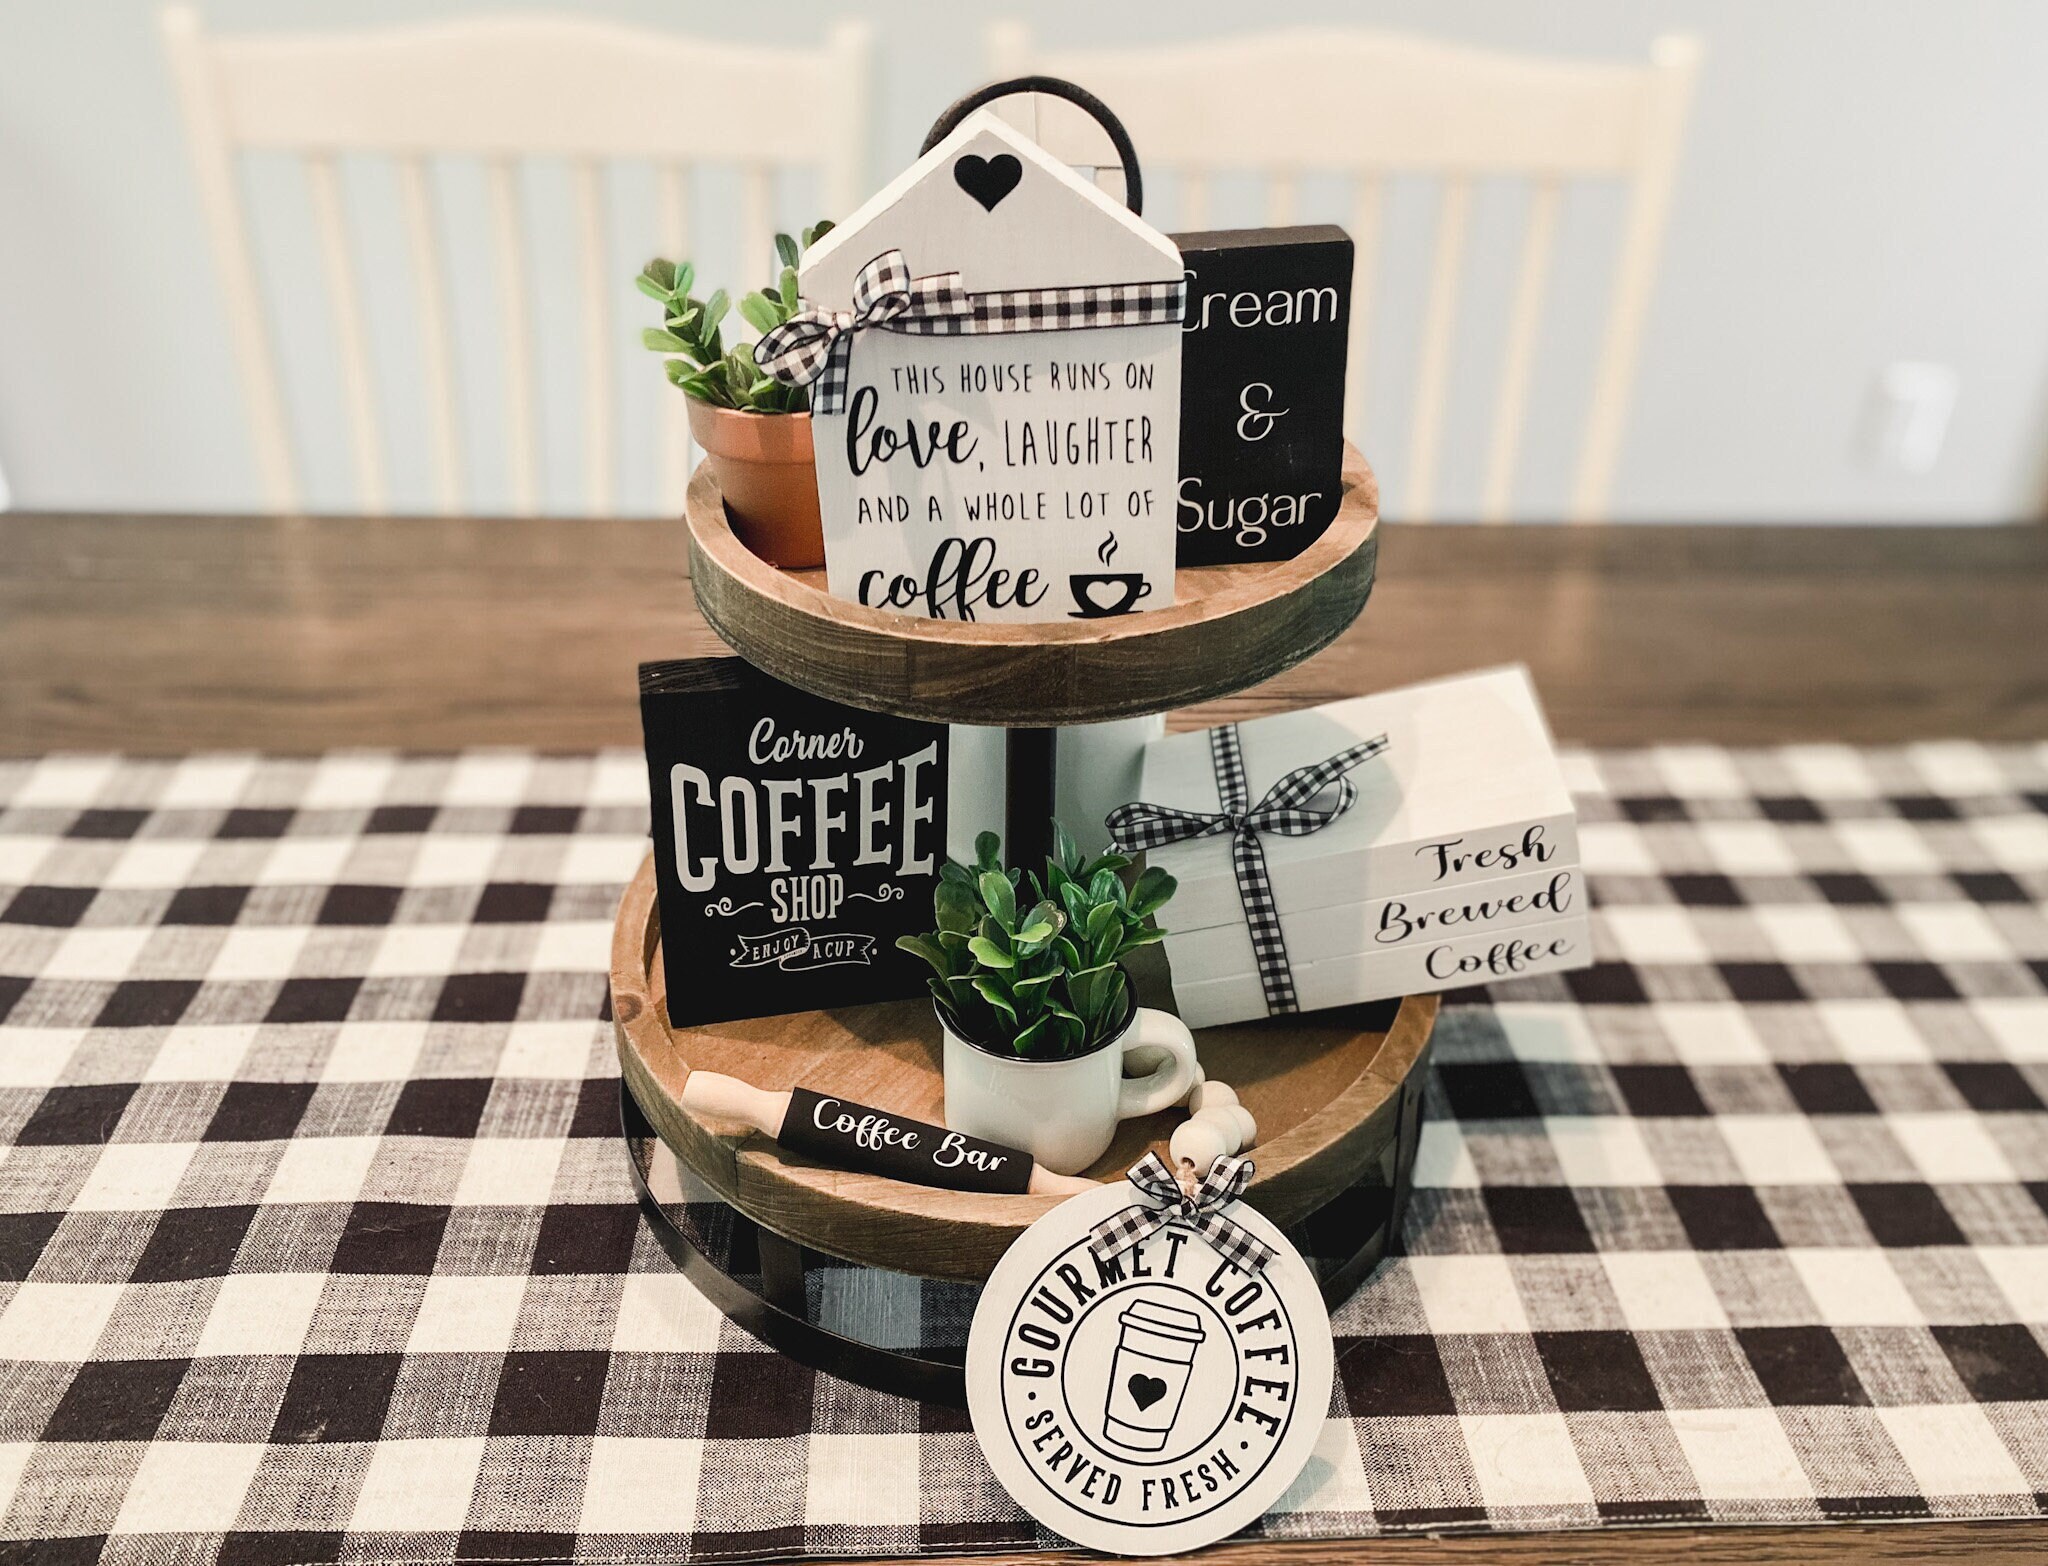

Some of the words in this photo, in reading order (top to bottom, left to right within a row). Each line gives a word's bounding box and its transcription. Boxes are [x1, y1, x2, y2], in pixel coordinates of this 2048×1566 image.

[890, 364, 945, 394] THIS
[960, 362, 1033, 394] HOUSE
[1051, 361, 1111, 392] RUNS
[1125, 362, 1155, 391] ON
[846, 385, 985, 477] love,
[1004, 415, 1153, 467] LAUGHTER
[1236, 382, 1290, 442] &
[858, 495, 910, 525] AND
[928, 495, 943, 523] A
[964, 491, 1047, 522] WHOLE
[1065, 490, 1110, 520] LOT
[1127, 489, 1155, 518] OF
[1177, 476, 1322, 547] Sugar
[858, 536, 1050, 622] coffee
[748, 716, 865, 765] Corner
[670, 739, 938, 893] COFFEE
[1414, 825, 1557, 881] Fresh
[770, 873, 844, 924] SHOP
[1374, 871, 1572, 944] Brewed
[752, 934, 800, 961] ENJOY
[1425, 939, 1576, 980] Coffee
[813, 1098, 921, 1151] Coffee
[932, 1132, 1008, 1172] Bar
[1011, 1231, 1189, 1379] GOURMET
[1205, 1259, 1291, 1438] COFFEE
[1025, 1408, 1122, 1505] SERVED
[1141, 1448, 1241, 1511] FRESH
